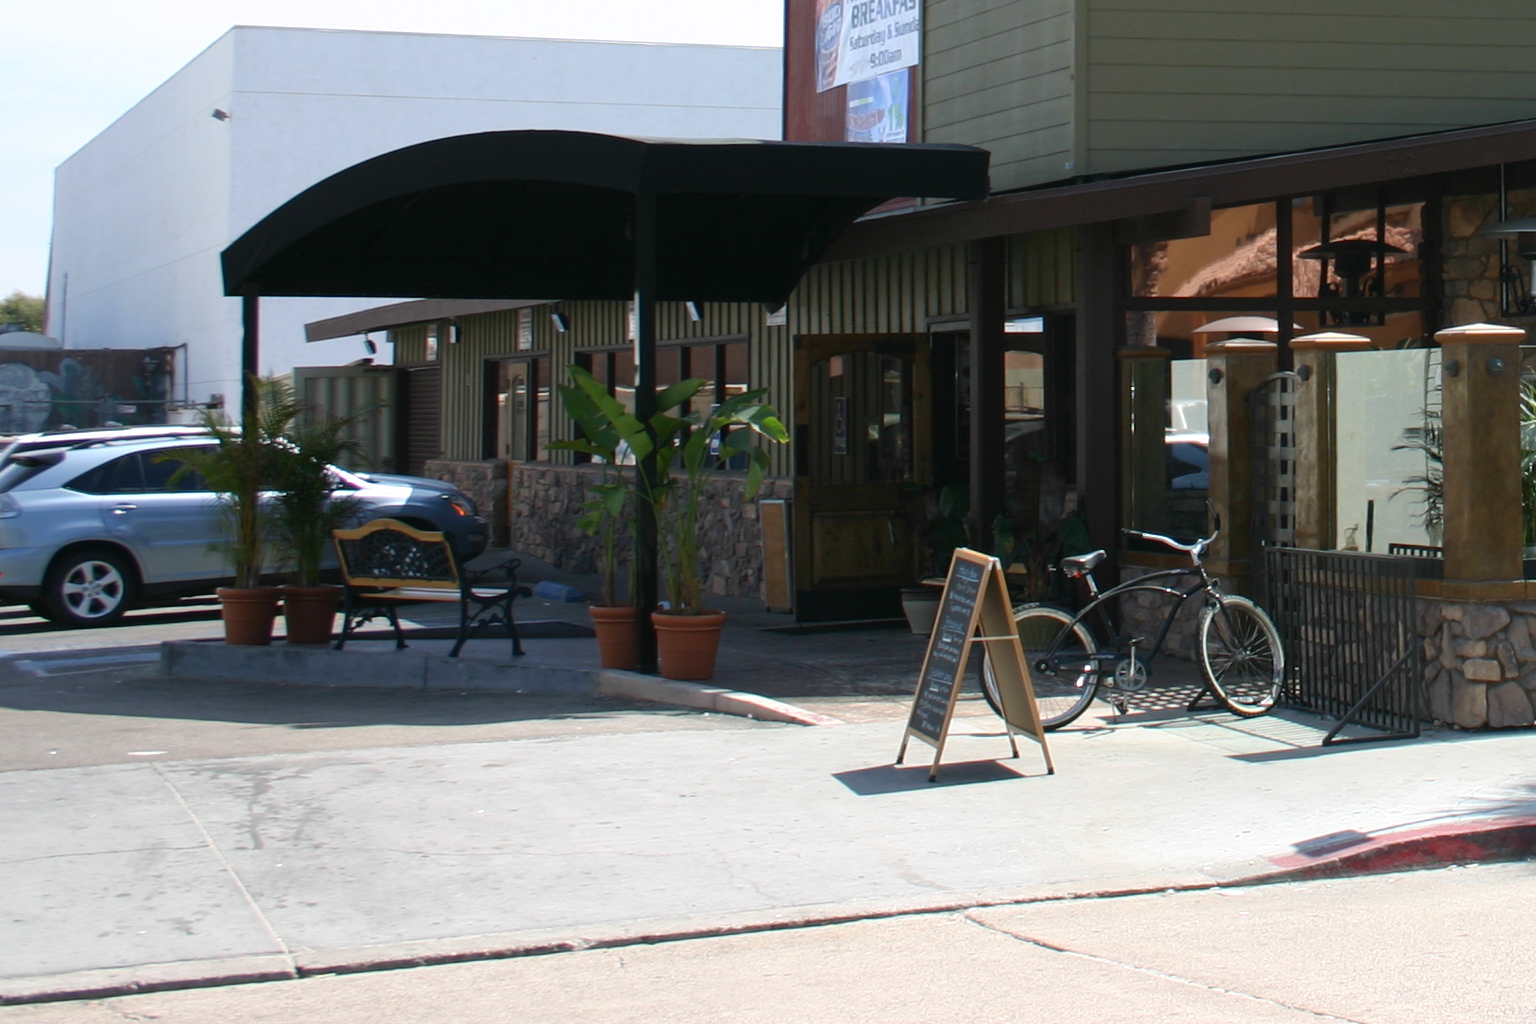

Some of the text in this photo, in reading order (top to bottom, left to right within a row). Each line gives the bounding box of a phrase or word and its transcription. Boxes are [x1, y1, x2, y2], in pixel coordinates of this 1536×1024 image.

[849, 29, 886, 51] Saturday
[894, 17, 920, 38] Sunda
[869, 49, 902, 68] 9:00am
